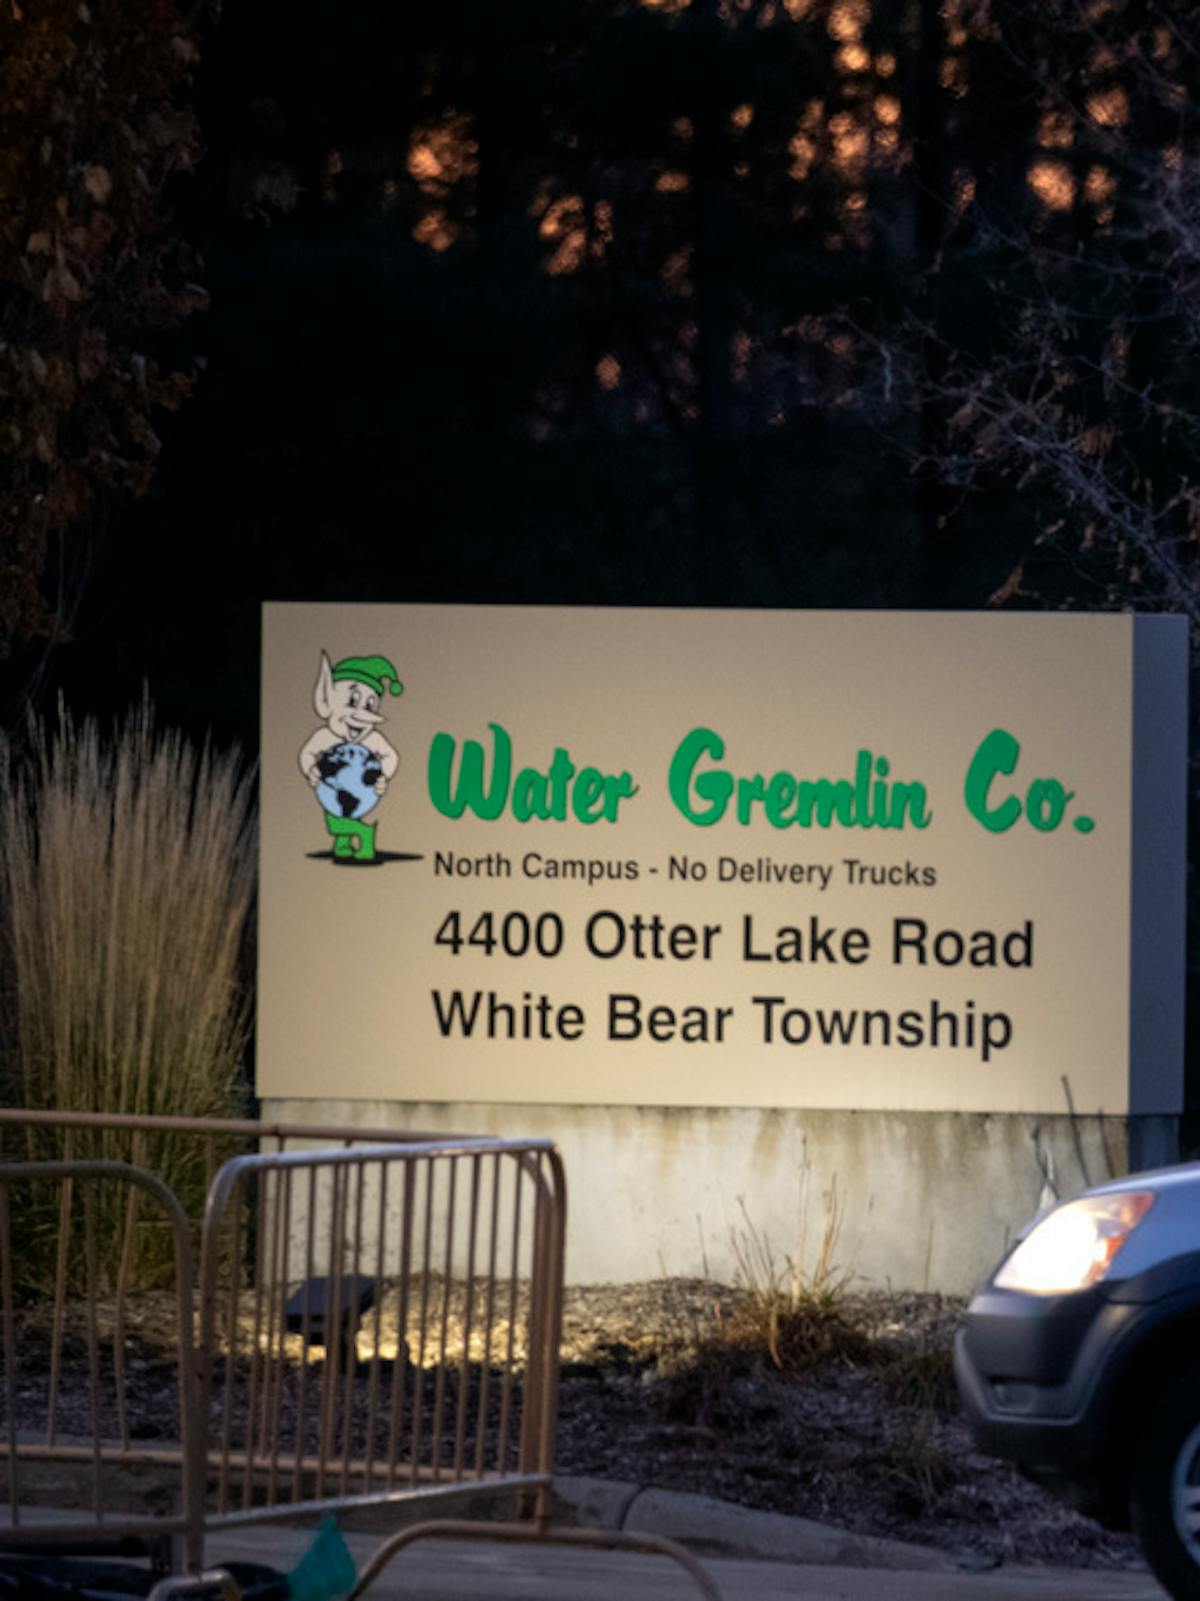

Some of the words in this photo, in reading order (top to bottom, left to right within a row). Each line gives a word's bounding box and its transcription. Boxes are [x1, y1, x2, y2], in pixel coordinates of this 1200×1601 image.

[428, 722, 639, 825] Water
[668, 727, 931, 830] Gremlin
[964, 728, 1096, 833] Co.
[434, 852, 512, 878] North
[523, 853, 639, 886] Campus
[669, 856, 707, 882] No
[719, 858, 833, 891] Delivery
[843, 860, 937, 887] Trucks
[434, 910, 565, 959] 4400
[585, 910, 722, 961] Otter
[743, 914, 871, 966] Lake
[893, 918, 1034, 969] Road
[431, 990, 586, 1041] White
[608, 994, 734, 1044] Bear
[752, 997, 1013, 1063] Township
